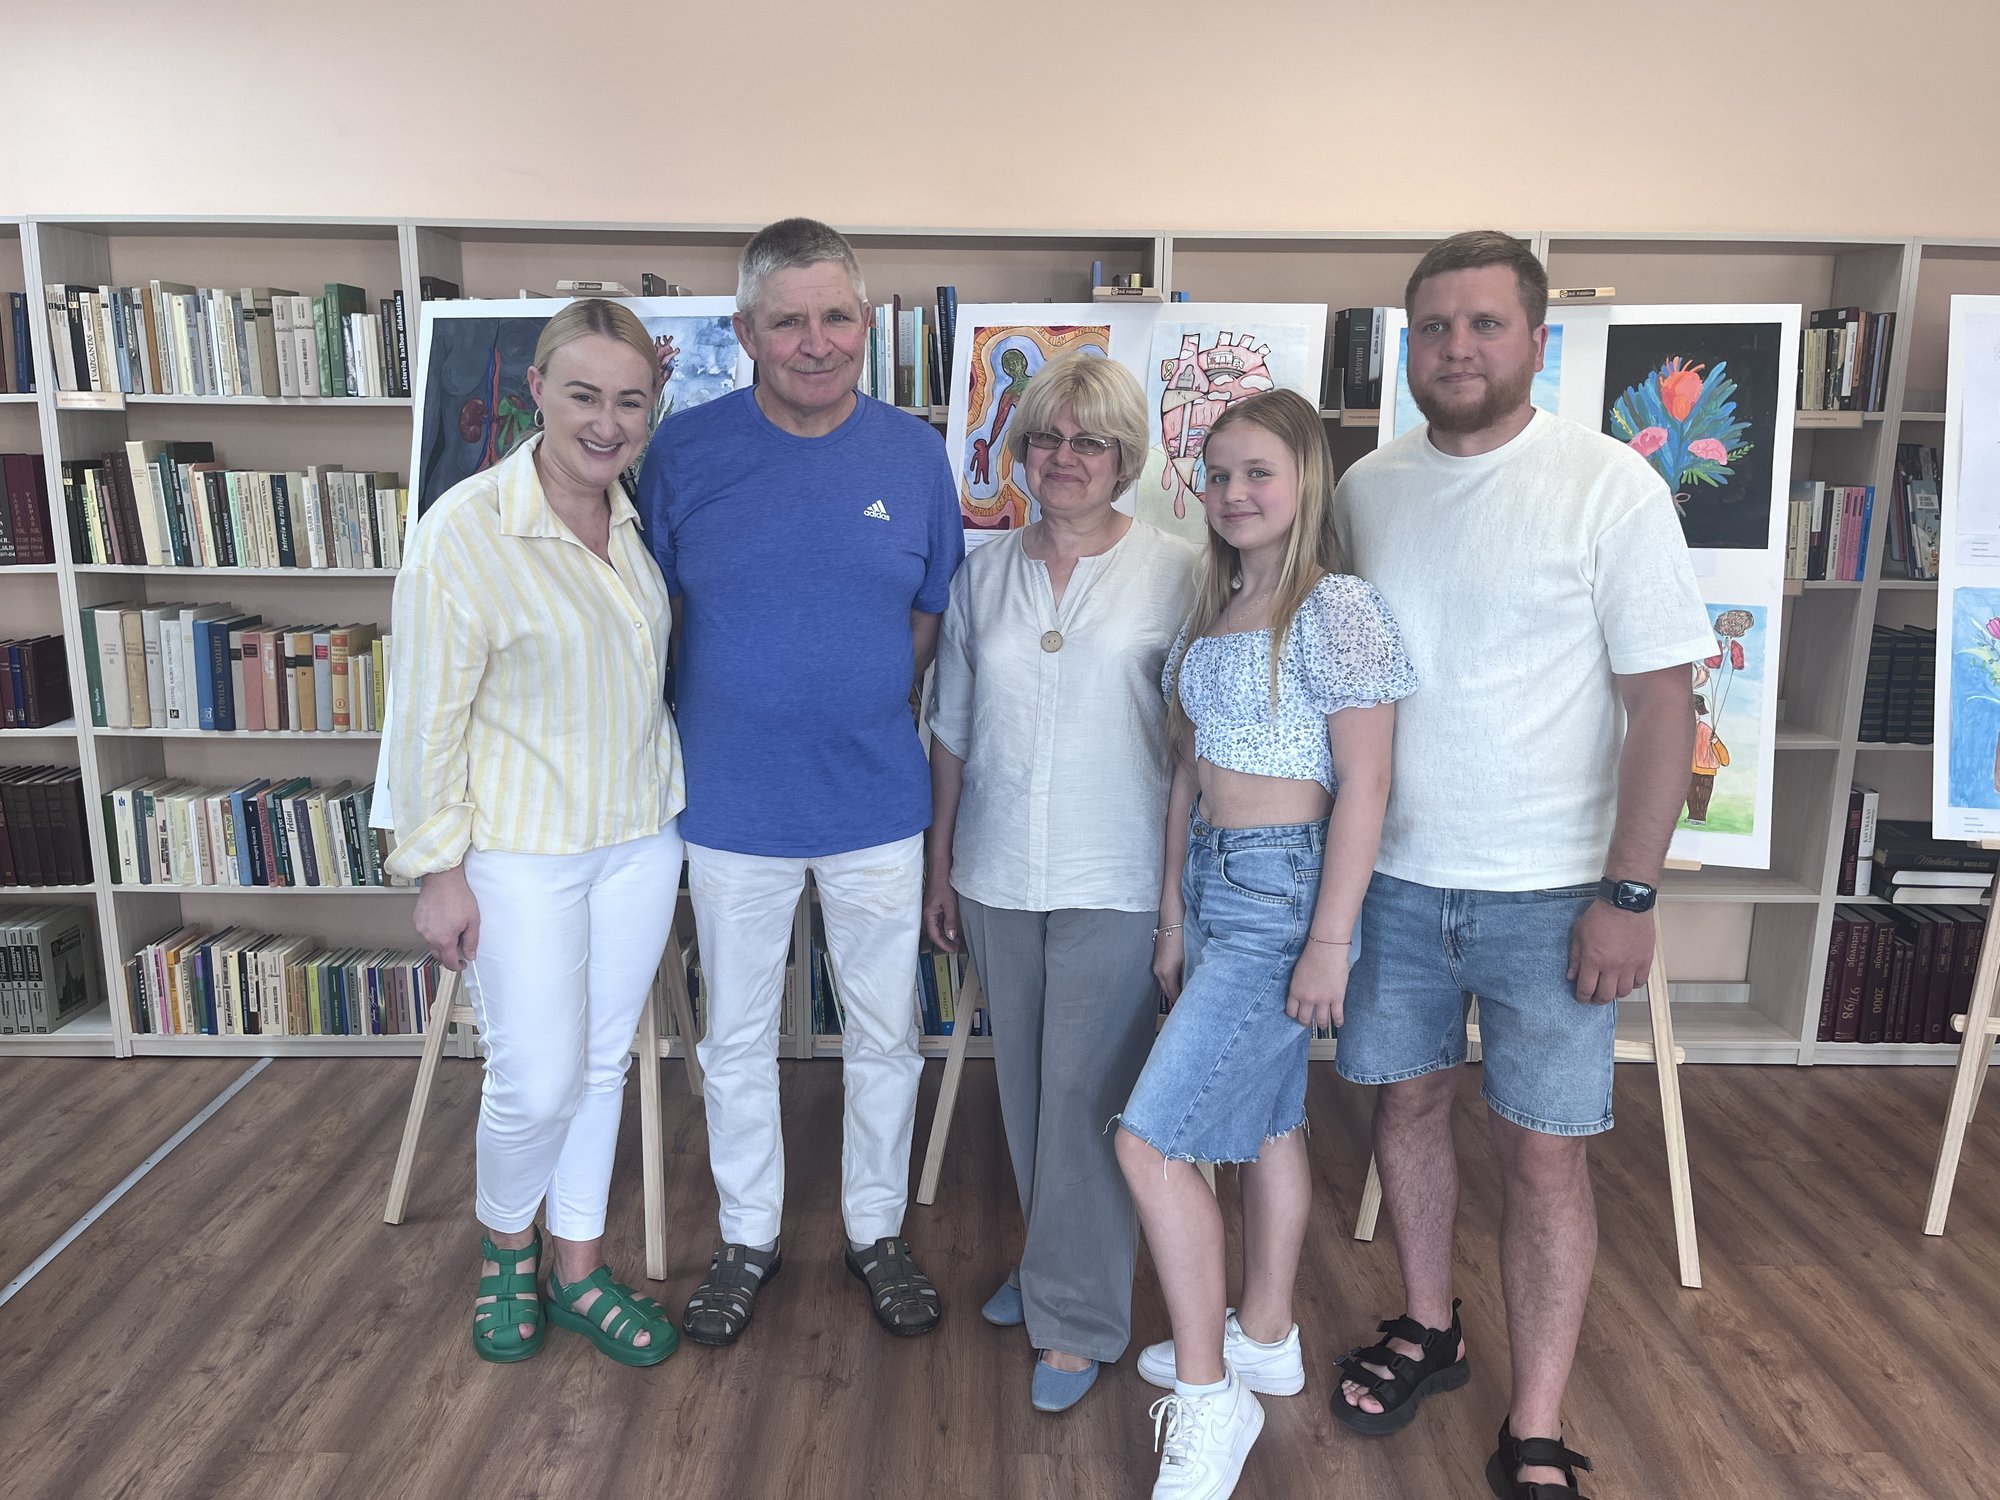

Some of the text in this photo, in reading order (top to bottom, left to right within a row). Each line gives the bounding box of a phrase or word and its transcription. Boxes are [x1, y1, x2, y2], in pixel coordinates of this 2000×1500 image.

[394, 295, 404, 331] didaktika
[87, 334, 98, 378] VAIŽGANTAS
[398, 333, 407, 358] kalbos
[1354, 347, 1364, 384] PASROVIUI
[275, 487, 285, 518] rašytojais
[864, 510, 890, 521] adidas
[306, 505, 315, 532] BARBORA
[281, 527, 289, 551] Interviu
[213, 635, 226, 717] LIETUVOS ISTORIJA
[285, 810, 295, 834] Telšiai
[124, 858, 132, 866] XX
[338, 839, 347, 860] Klimas
[341, 860, 350, 879] Petras
[1830, 931, 1845, 955] 95/96
[1842, 926, 1862, 1019] Lietuvoje 97/98
[1872, 927, 1888, 1014] Lietuvoje 2000
